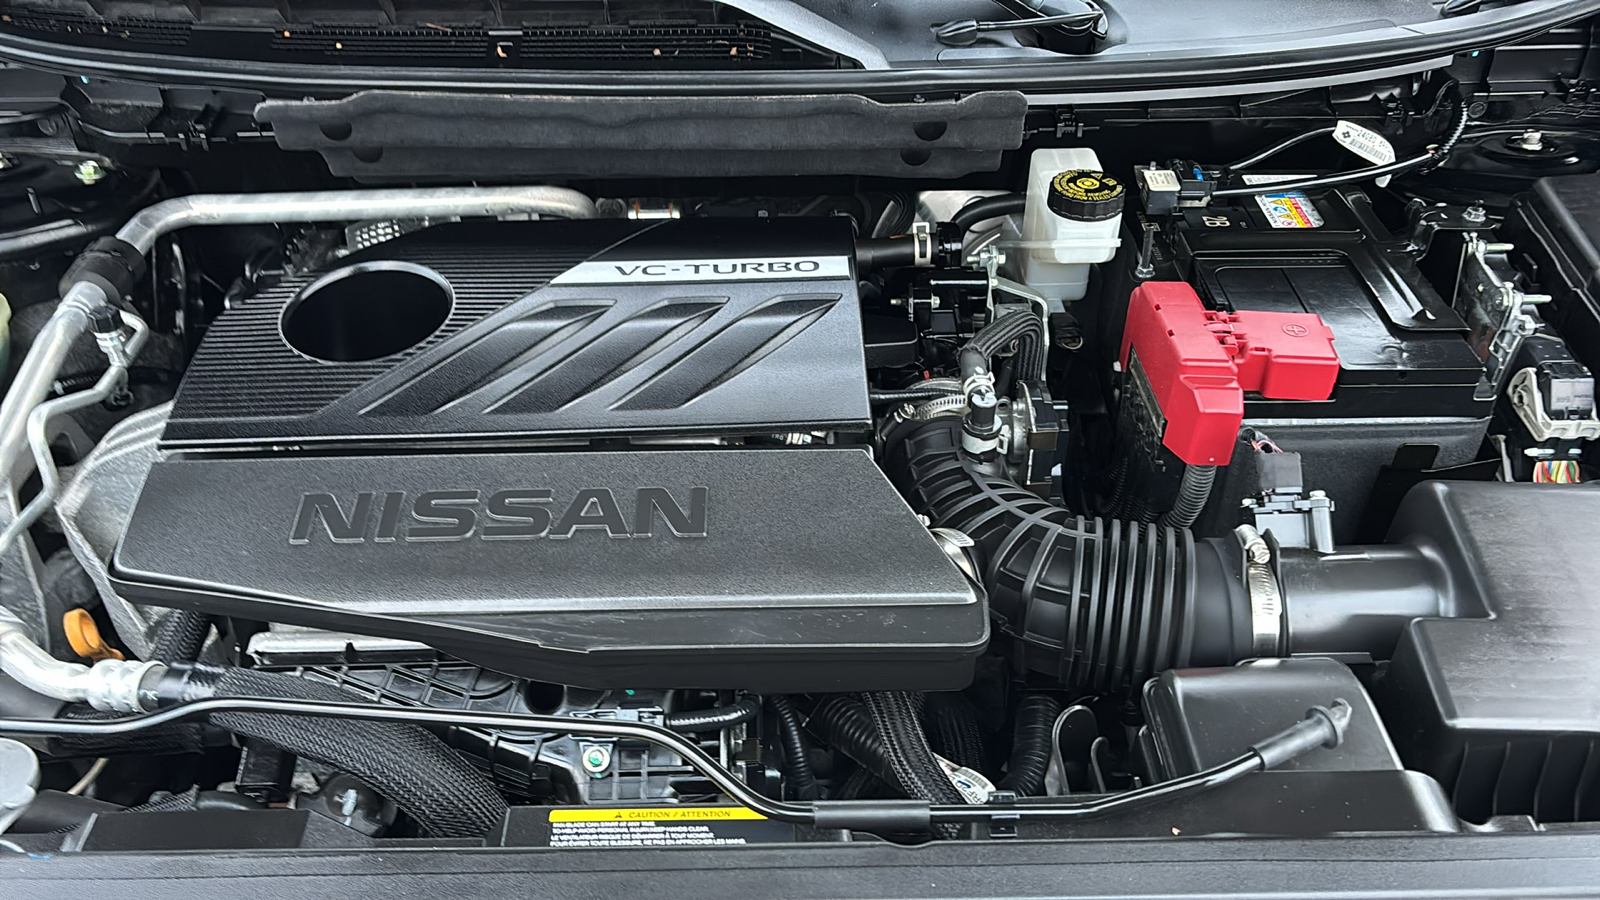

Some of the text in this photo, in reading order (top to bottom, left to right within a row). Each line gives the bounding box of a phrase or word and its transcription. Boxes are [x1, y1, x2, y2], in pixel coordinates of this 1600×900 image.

[1201, 215, 1231, 228] 2B
[614, 260, 820, 276] VC-TURBO
[288, 486, 710, 545] NISSAN
[628, 811, 670, 819] CAUTION
[680, 810, 731, 818] ATTENTION
